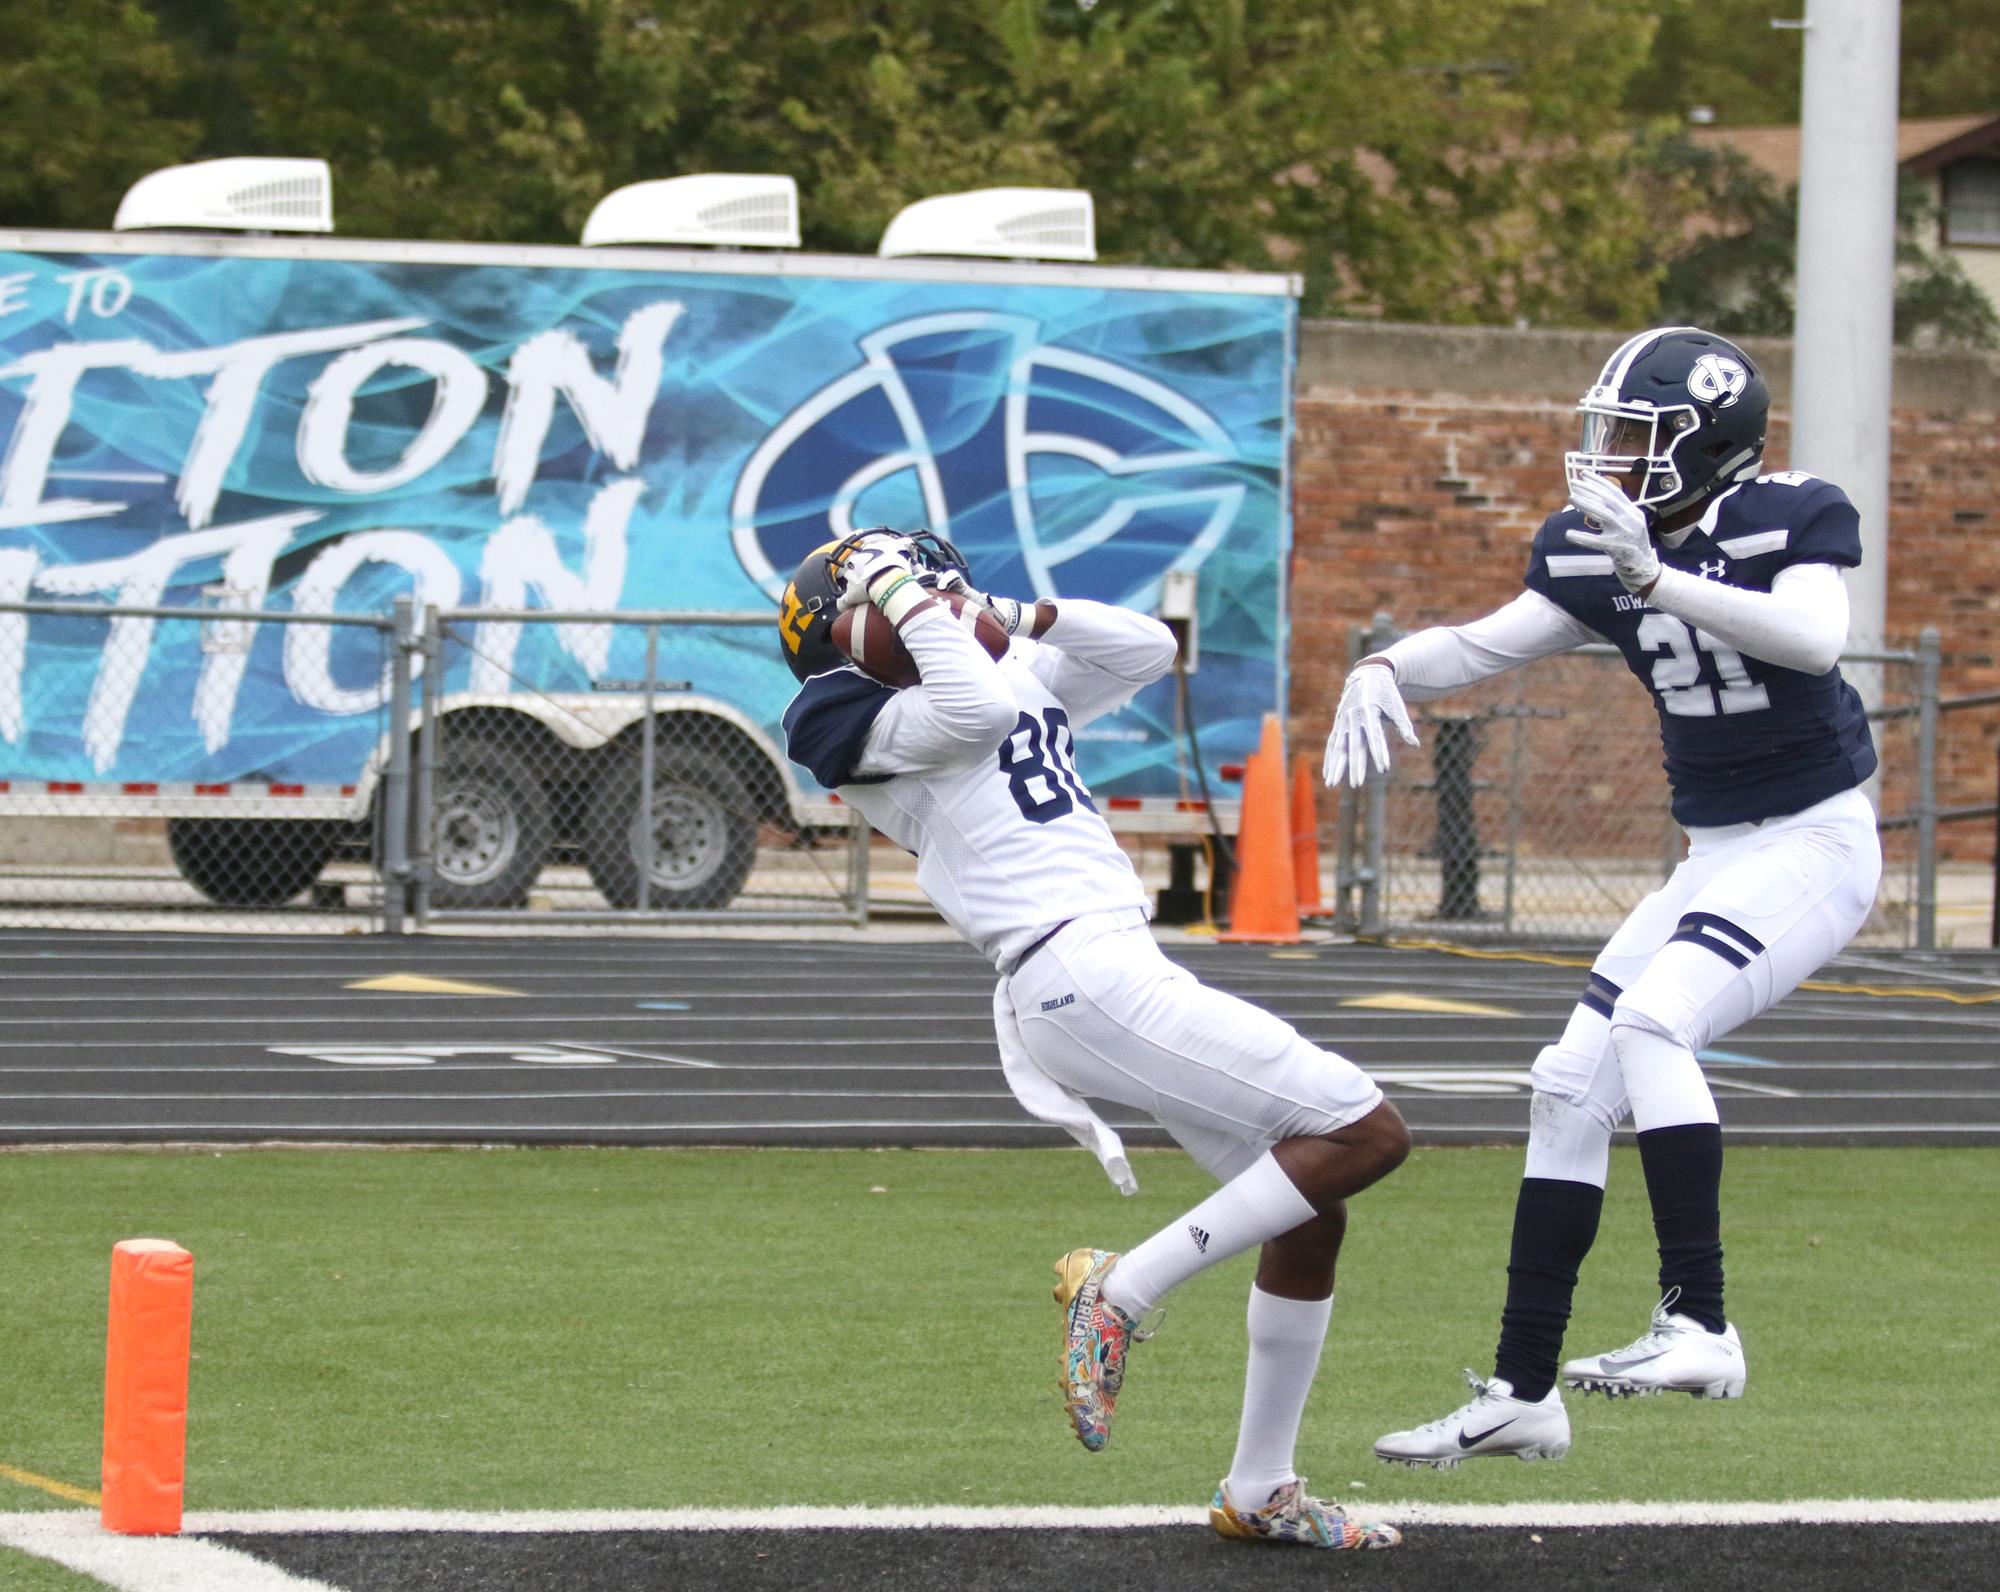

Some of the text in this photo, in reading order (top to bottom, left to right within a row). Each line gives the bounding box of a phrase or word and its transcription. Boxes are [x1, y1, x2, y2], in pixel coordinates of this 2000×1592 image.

[54, 267, 133, 326] TO
[0, 477, 648, 776] TION
[1637, 613, 1771, 717] 21
[998, 707, 1100, 825] 80
[1041, 993, 1075, 1012] HIGHLAND
[1070, 1276, 1099, 1337] AMERICA
